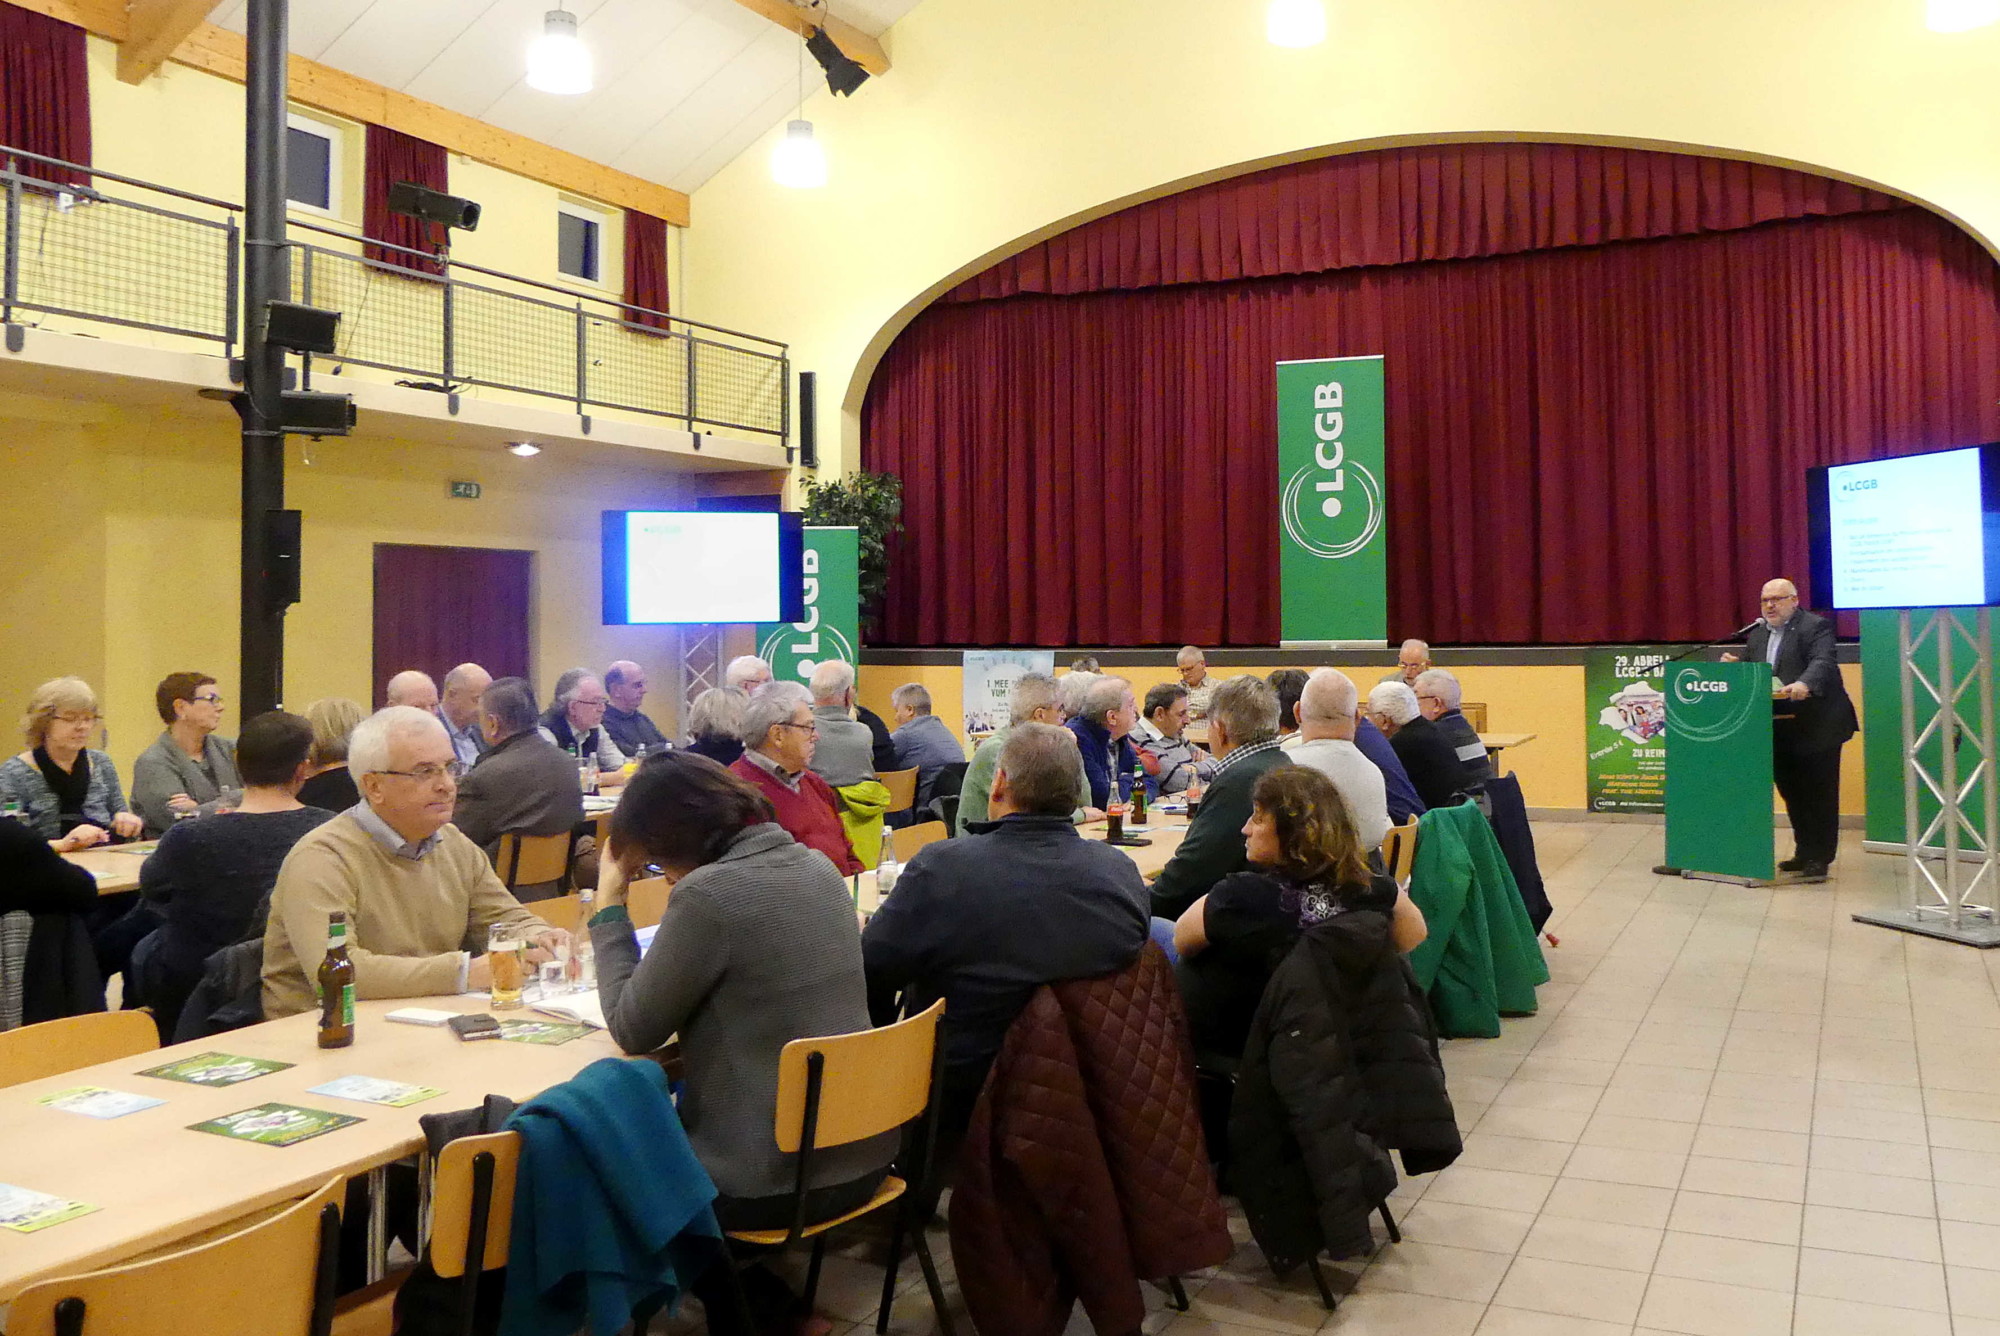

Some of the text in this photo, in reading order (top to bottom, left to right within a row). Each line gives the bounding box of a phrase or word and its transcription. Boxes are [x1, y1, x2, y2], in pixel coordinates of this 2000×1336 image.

[1314, 381, 1344, 492] LCGB
[1849, 479, 1878, 492] LCGB
[1615, 655, 1630, 667] 29.
[1694, 680, 1728, 693] LCGB
[1632, 748, 1643, 758] ZU
